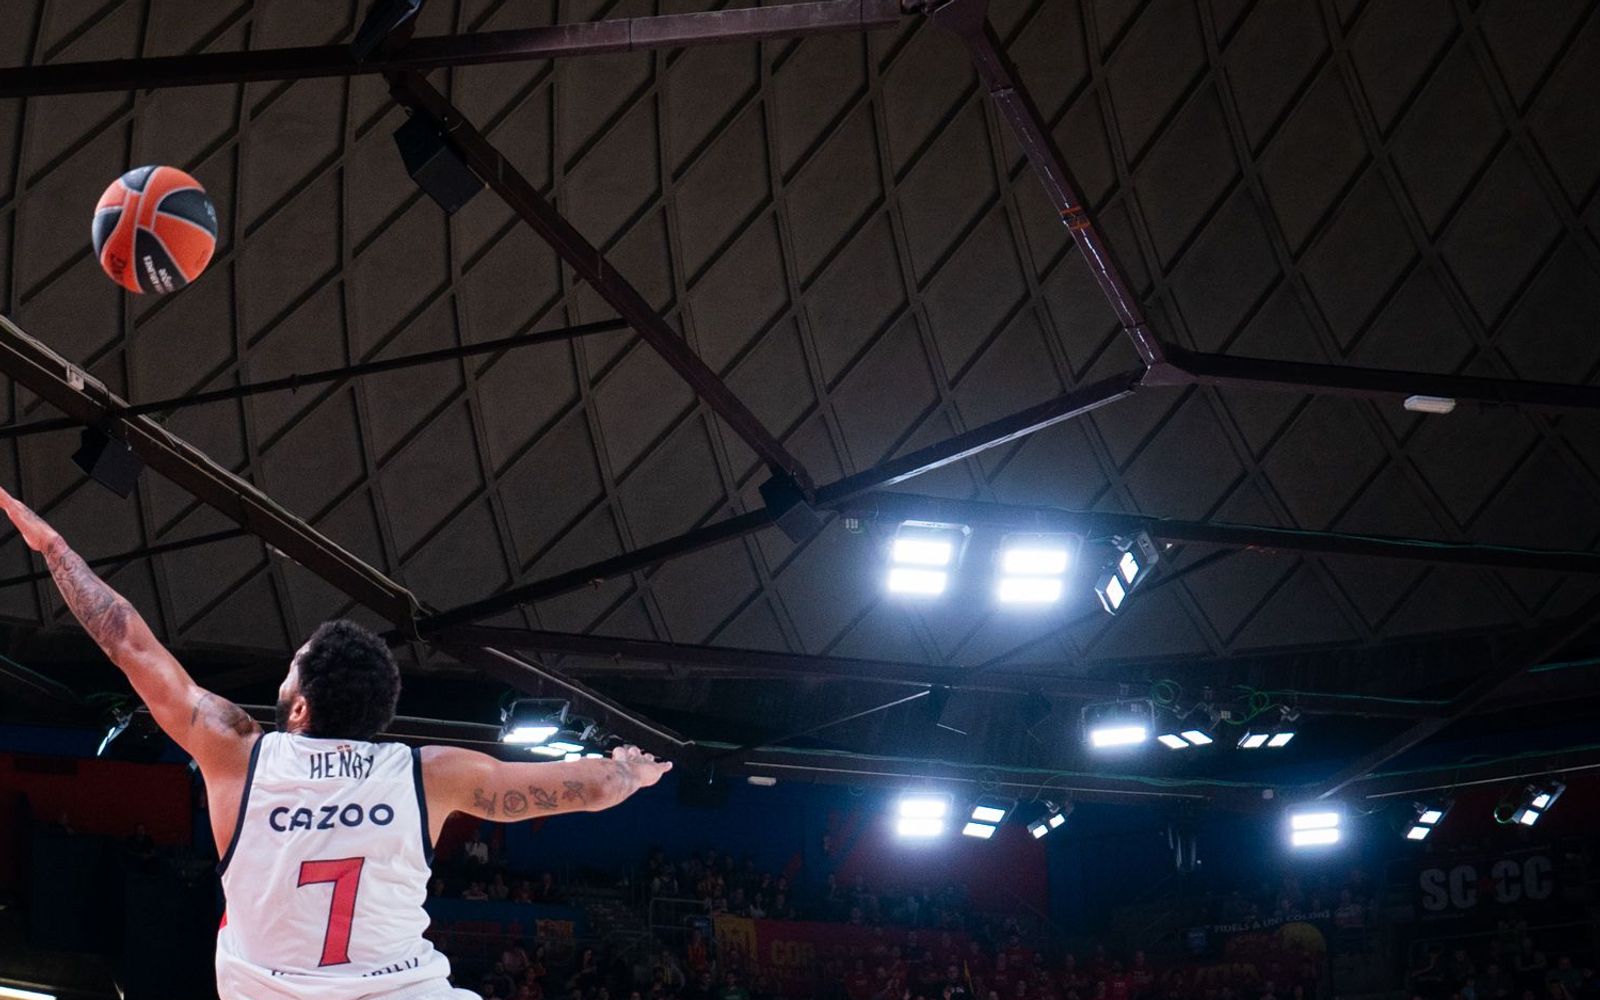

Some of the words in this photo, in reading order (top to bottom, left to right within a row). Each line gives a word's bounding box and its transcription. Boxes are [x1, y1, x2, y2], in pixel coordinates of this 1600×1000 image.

[310, 751, 374, 780] HENRY
[269, 803, 395, 832] CAZOO
[297, 856, 366, 968] 7
